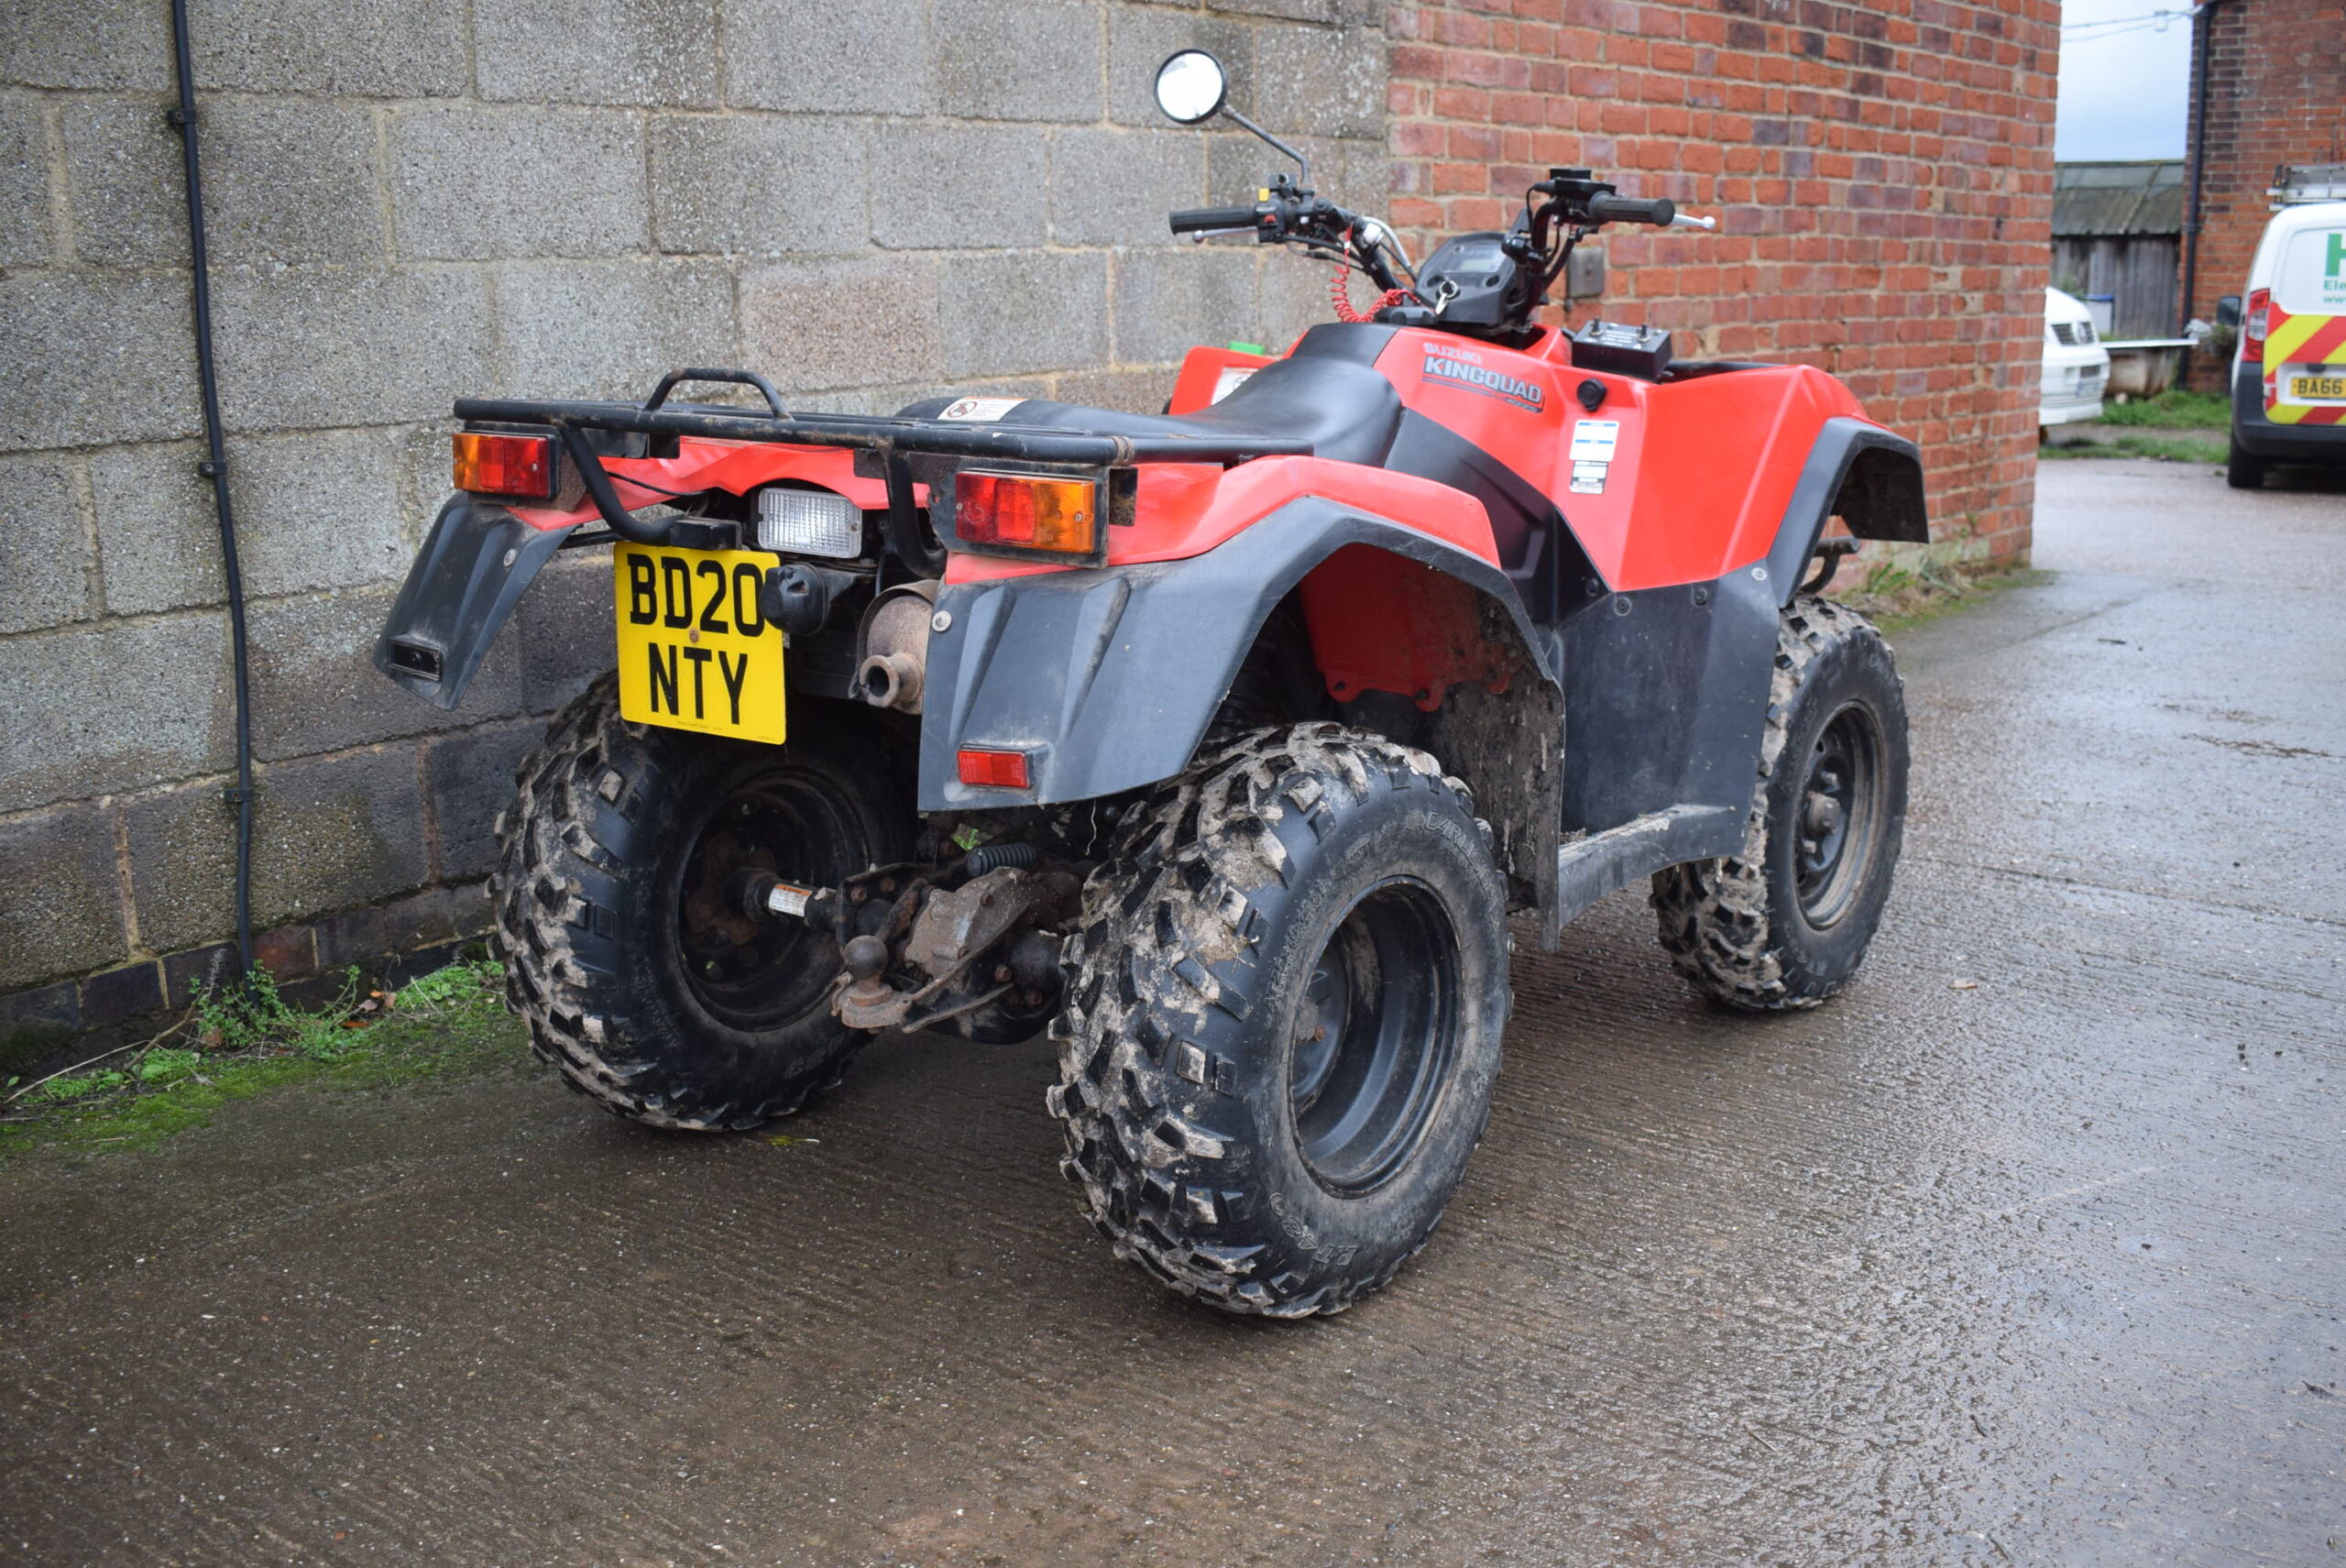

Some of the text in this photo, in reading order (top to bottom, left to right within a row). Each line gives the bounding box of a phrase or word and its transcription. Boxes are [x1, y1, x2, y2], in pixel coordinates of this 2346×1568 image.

[1423, 342, 1483, 365] SUZUKI
[1423, 355, 1543, 404] KINGQUAD
[2297, 378, 2342, 395] BA66
[627, 553, 765, 638] BD20
[648, 641, 749, 725] NTY
